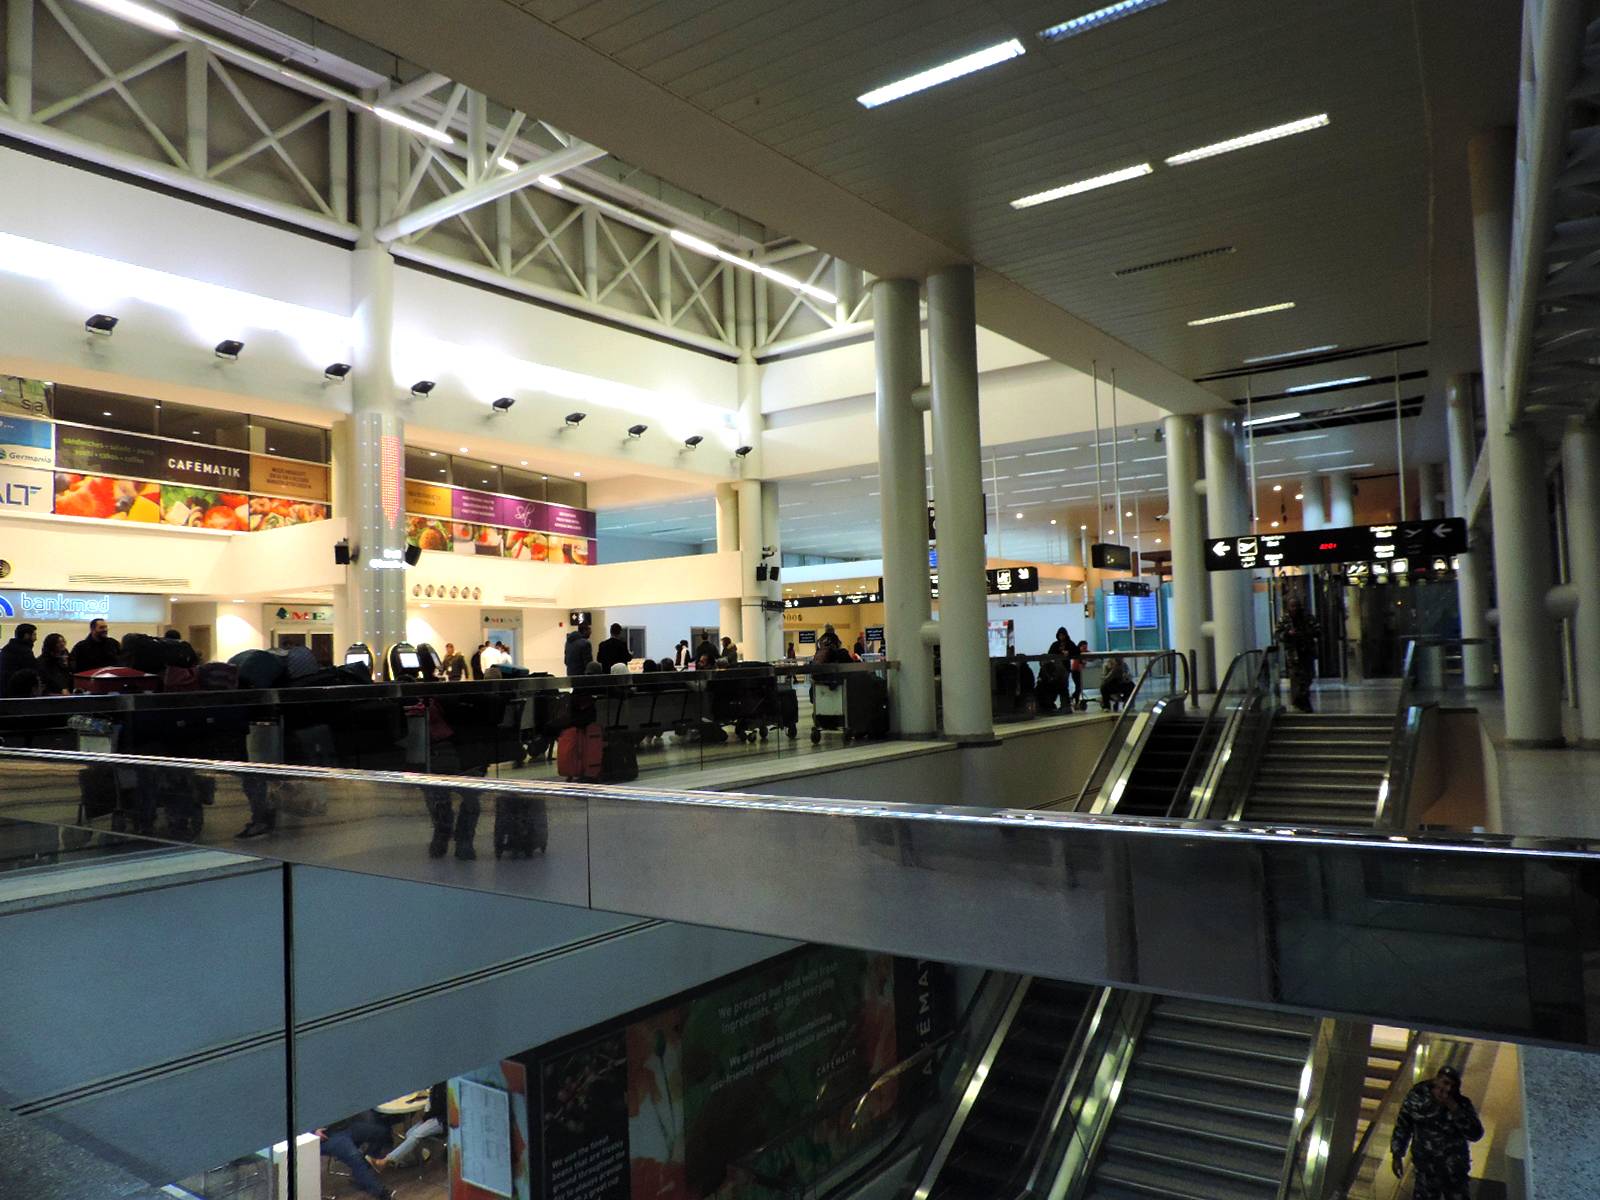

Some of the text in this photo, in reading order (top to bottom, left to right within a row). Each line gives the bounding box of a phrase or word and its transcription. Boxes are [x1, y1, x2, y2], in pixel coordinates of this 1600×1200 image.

[9, 451, 52, 463] Germania
[167, 458, 241, 478] CAFEMATIK
[0, 482, 41, 506] LT
[21, 592, 110, 612] bankmed
